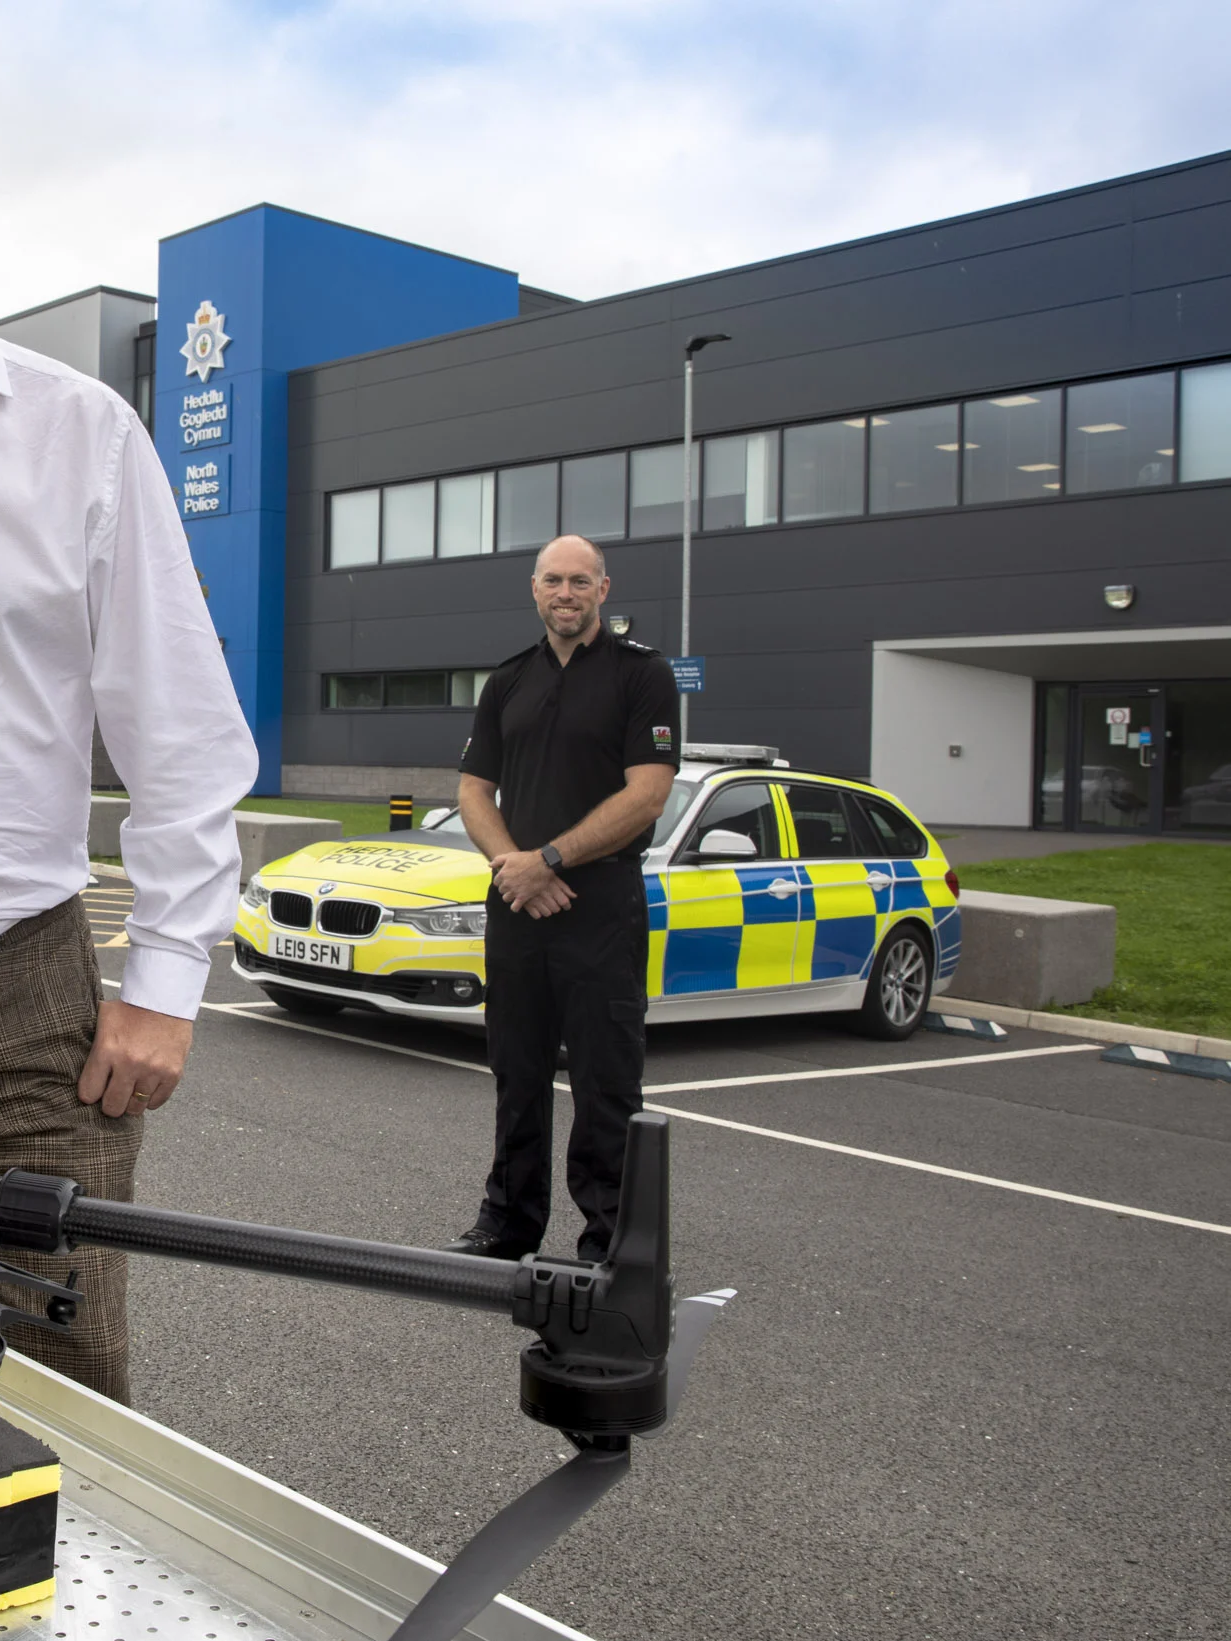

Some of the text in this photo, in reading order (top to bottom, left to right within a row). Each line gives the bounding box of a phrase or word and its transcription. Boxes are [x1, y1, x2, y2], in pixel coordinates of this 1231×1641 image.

[183, 389, 223, 410] Heddlu
[180, 404, 227, 428] Gogledd
[184, 426, 221, 446] Cymru
[186, 462, 218, 480] North
[184, 480, 219, 497] Wales
[184, 496, 219, 514] Police
[320, 853, 419, 873] POLICE
[335, 846, 445, 863] HEDDLU
[275, 936, 341, 965] LE19 SFN
